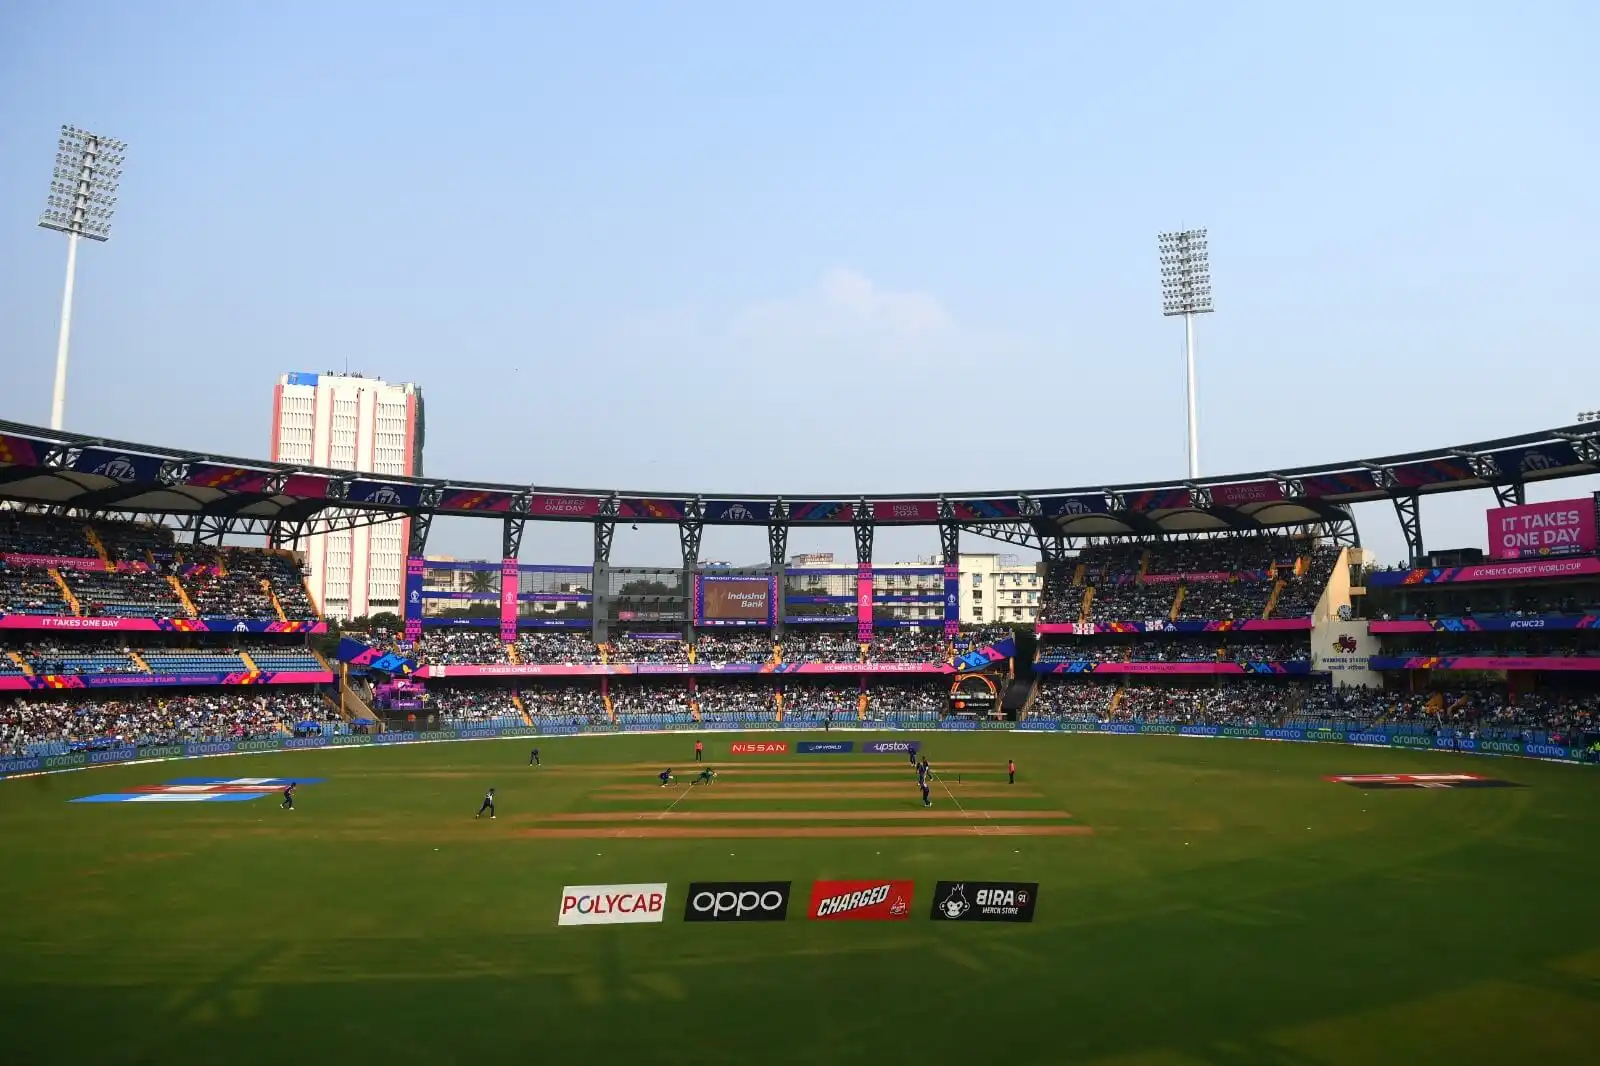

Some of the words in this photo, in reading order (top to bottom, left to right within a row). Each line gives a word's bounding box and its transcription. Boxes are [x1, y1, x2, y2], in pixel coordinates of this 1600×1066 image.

[1502, 517, 1517, 531] IT
[1521, 510, 1580, 529] TAKES
[1503, 531, 1540, 547] ONE
[1543, 528, 1581, 544] DAY
[1485, 567, 1507, 576] MEN'S
[1507, 565, 1537, 575] CRICKET
[1538, 563, 1565, 573] WORLD
[1565, 562, 1581, 571] CUP
[727, 591, 766, 600] IndusInd
[741, 600, 764, 608] Bank
[42, 618, 52, 626] IT
[52, 618, 81, 627] TAKES
[81, 619, 101, 627] ONE
[101, 619, 119, 628] DAY
[1510, 619, 1545, 628] #CWC23
[543, 725, 578, 733] aramco
[665, 722, 699, 730] aramco
[704, 721, 738, 729] aramco
[744, 721, 778, 729] aramco
[784, 721, 817, 729] aramco
[863, 721, 896, 729] aramco
[902, 721, 935, 729] aramco
[941, 721, 975, 729] aramco
[981, 721, 1015, 729] aramco
[1021, 721, 1056, 729] aramco
[1062, 722, 1095, 730] aramco
[1101, 723, 1135, 731] aramco
[1141, 724, 1176, 733] aramco
[1182, 725, 1217, 734] aramco
[420, 730, 455, 739] aramco
[461, 728, 496, 737] aramco
[502, 727, 537, 735] aramco
[1224, 727, 1259, 736] aramco
[1265, 728, 1300, 738] aramco
[1307, 731, 1343, 740] aramco
[333, 735, 371, 744] aramco
[377, 732, 414, 742] aramco
[1349, 732, 1386, 742] aramco
[1392, 735, 1431, 745] aramco
[237, 740, 278, 750] aramco
[285, 737, 325, 747] aramco
[1481, 741, 1519, 752] aramco
[139, 746, 181, 757] aramco
[188, 743, 230, 753] aramco
[732, 744, 785, 752] NISSAN
[874, 741, 909, 753] upstox
[46, 754, 85, 766] aramco
[91, 749, 132, 762] aramco
[817, 884, 891, 917] CHARGED
[976, 889, 1014, 906] BIRA
[1017, 894, 1027, 903] 91
[562, 893, 663, 914] POLYCAB
[692, 890, 783, 917] oppo
[982, 906, 1001, 914] MERCH
[1001, 907, 1018, 915] STORE
